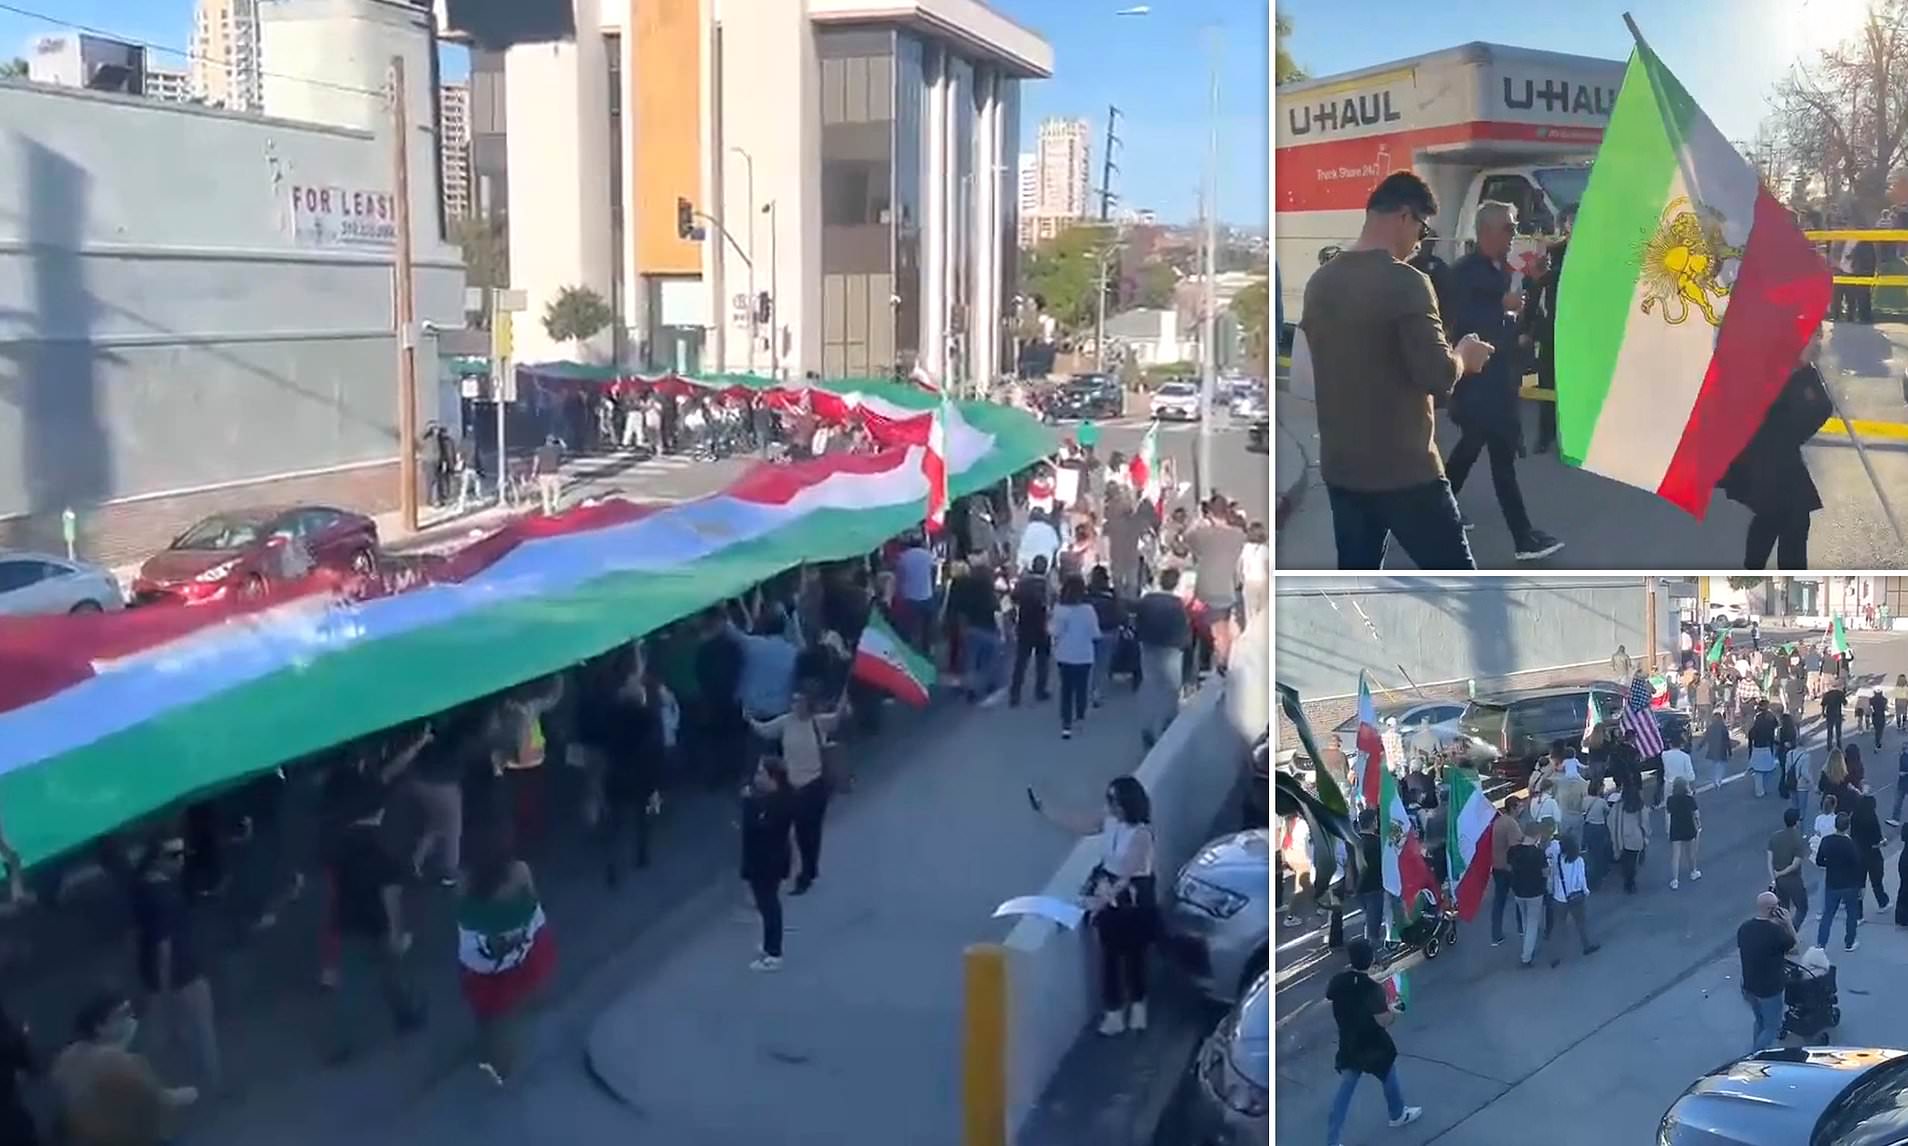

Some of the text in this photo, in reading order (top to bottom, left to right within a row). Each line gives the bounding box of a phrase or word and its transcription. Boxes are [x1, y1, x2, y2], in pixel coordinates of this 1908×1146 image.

[1289, 90, 1401, 135] U-HAUL
[1503, 76, 1617, 115] U-HAU
[292, 186, 332, 214] FOR
